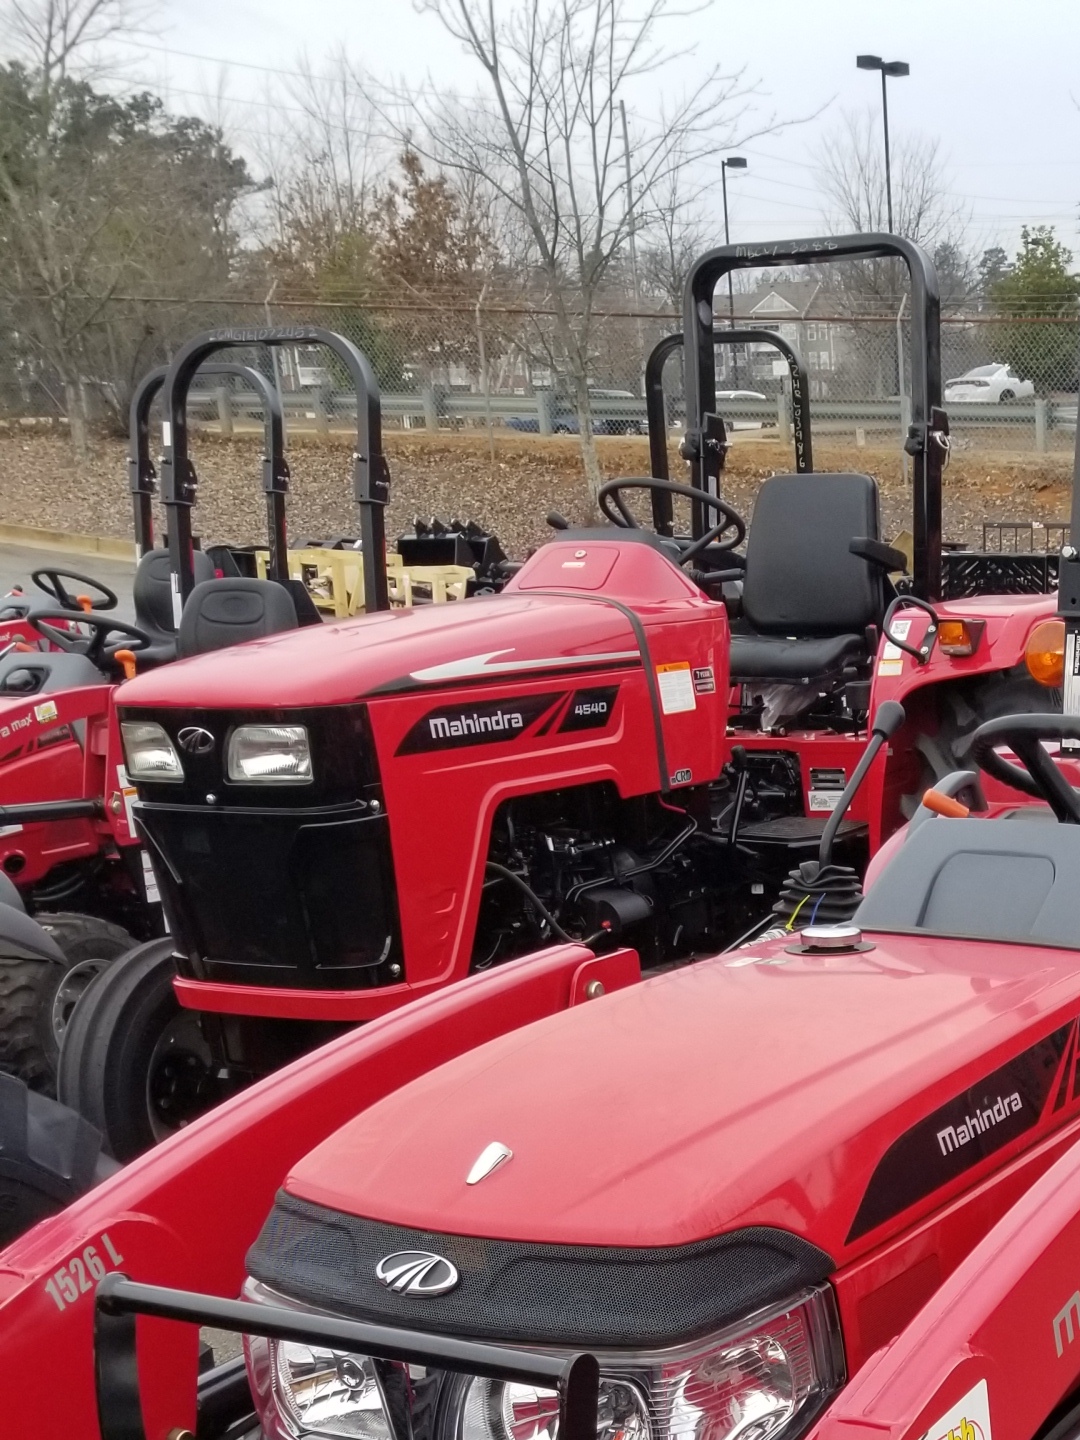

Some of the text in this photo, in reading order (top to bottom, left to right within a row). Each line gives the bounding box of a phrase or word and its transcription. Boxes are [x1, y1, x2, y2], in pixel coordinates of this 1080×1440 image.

[429, 710, 523, 738] Mahindra
[574, 702, 607, 715] 4540
[936, 1092, 1023, 1156] Mahindra
[44, 1233, 124, 1311] 1526 L
